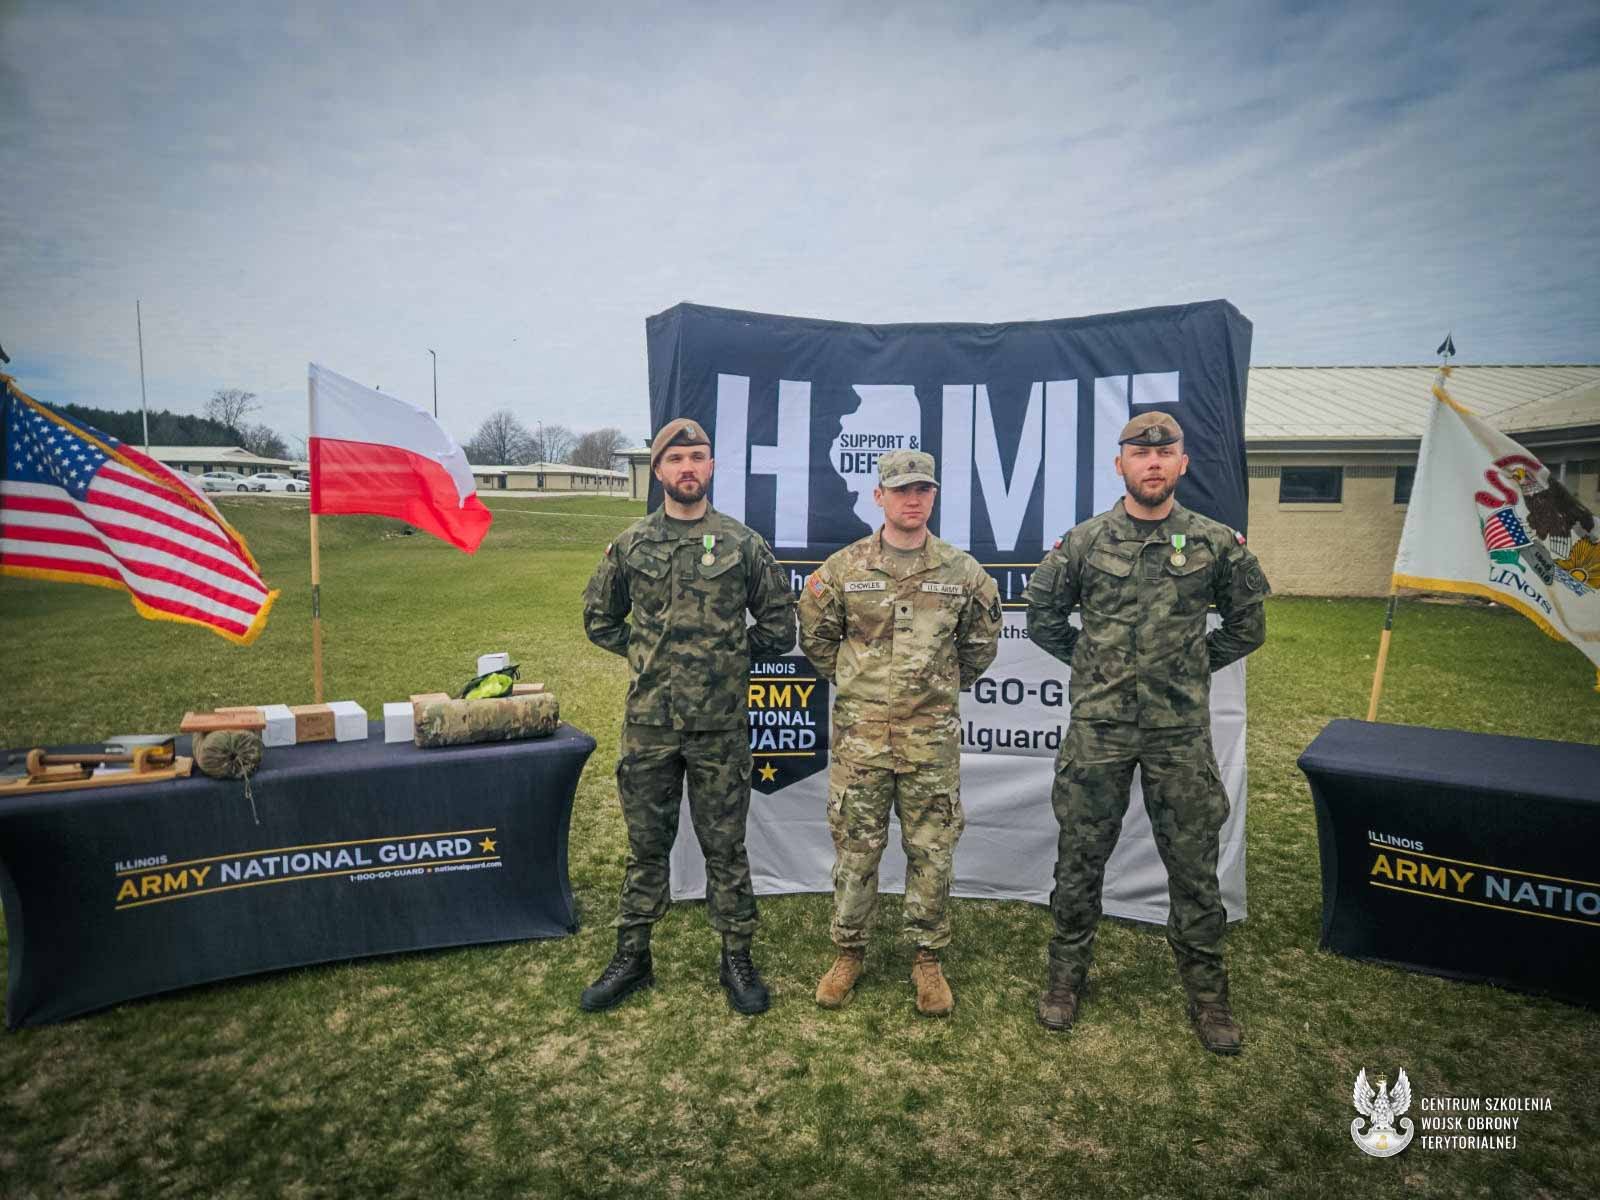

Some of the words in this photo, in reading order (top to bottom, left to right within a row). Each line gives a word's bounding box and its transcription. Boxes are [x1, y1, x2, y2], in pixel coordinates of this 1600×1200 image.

[840, 433, 905, 449] SUPPORT
[908, 435, 920, 450] &
[840, 452, 882, 474] DEF
[1488, 565, 1553, 615] LINOIS
[750, 662, 797, 675] LINOIS
[747, 684, 817, 709] RMY
[959, 677, 1072, 707] -GO-G
[747, 710, 817, 726] TIONAL
[1367, 829, 1425, 851] ILLINOIS
[115, 854, 169, 872] ILLINOIS
[116, 865, 213, 902] ARMY
[219, 847, 373, 883] NATIONAL
[378, 838, 473, 864] GUARD
[1369, 853, 1476, 894] ARMY
